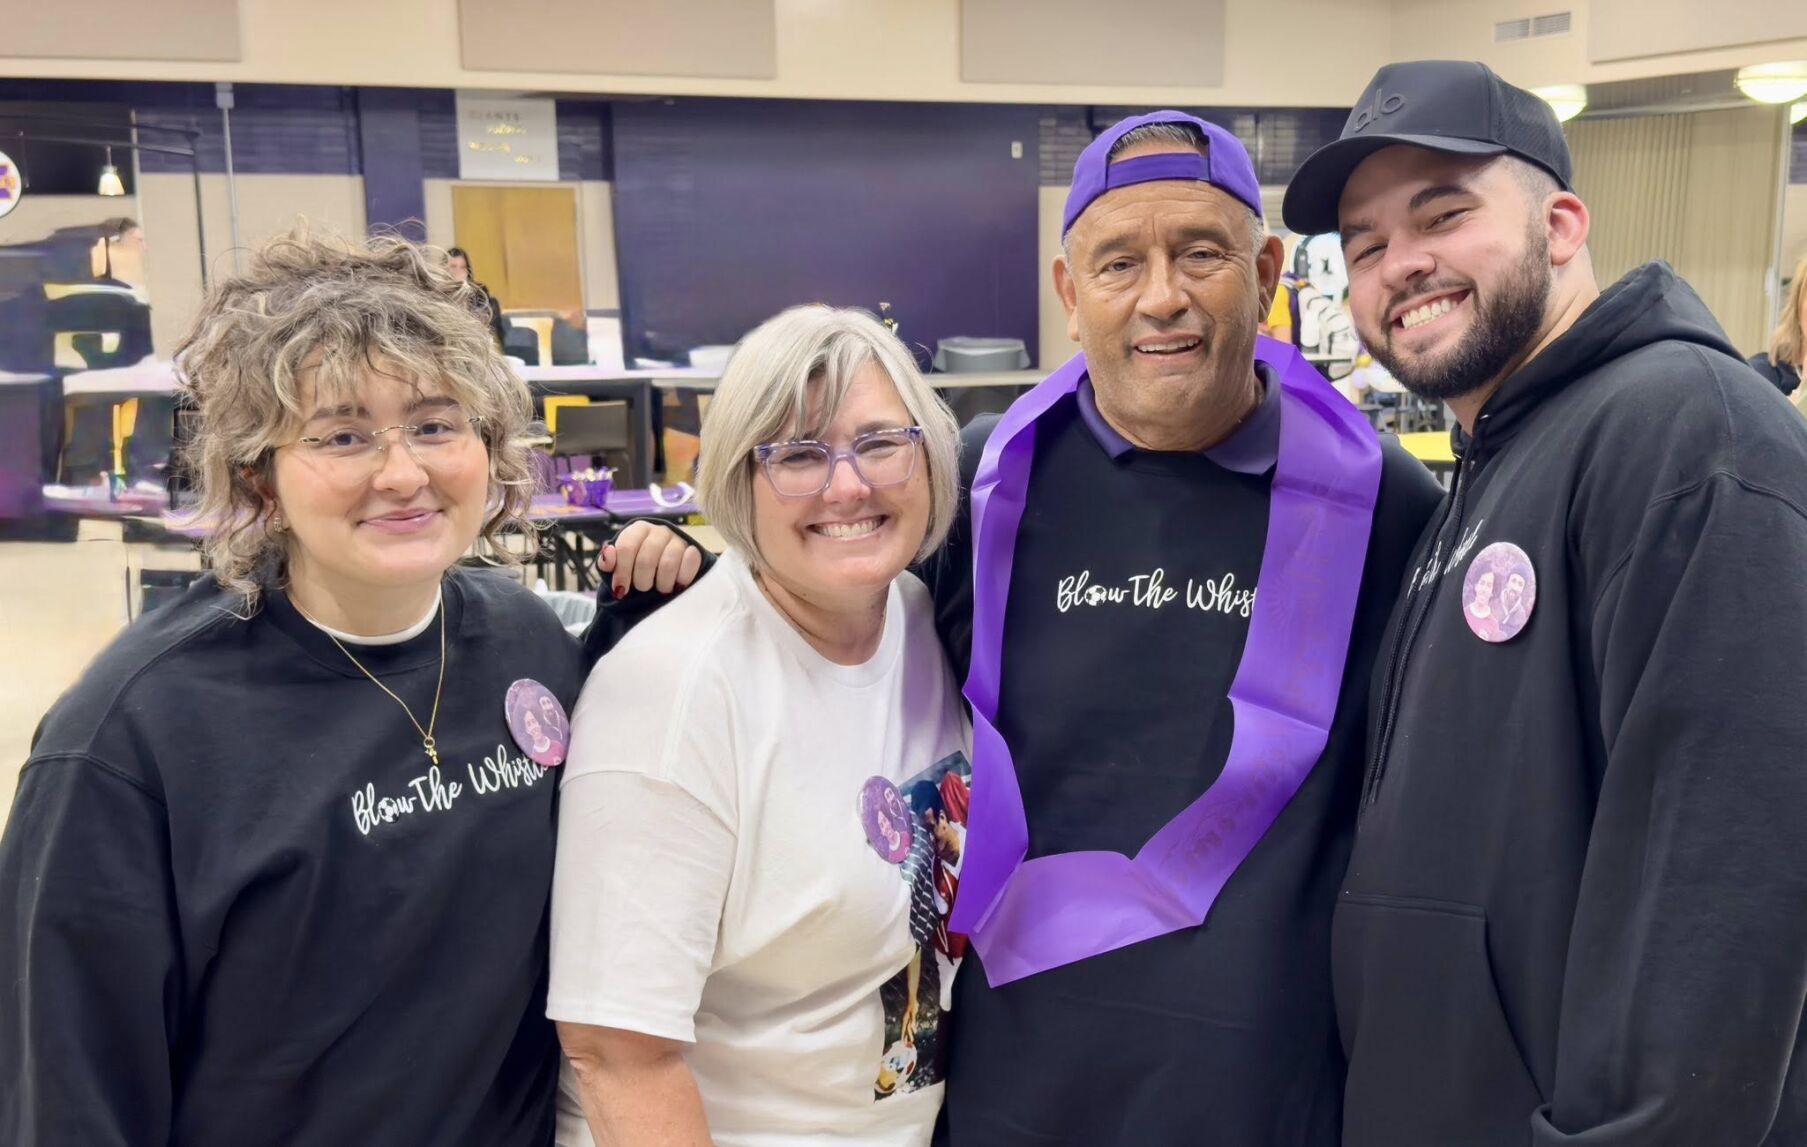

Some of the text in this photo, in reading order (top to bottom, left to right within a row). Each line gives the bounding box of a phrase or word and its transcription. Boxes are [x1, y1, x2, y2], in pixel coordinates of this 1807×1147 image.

[1354, 89, 1406, 133] alo
[1128, 568, 1178, 609] The
[1186, 572, 1257, 618] Whist
[408, 765, 462, 812] The
[467, 743, 549, 795] Whist
